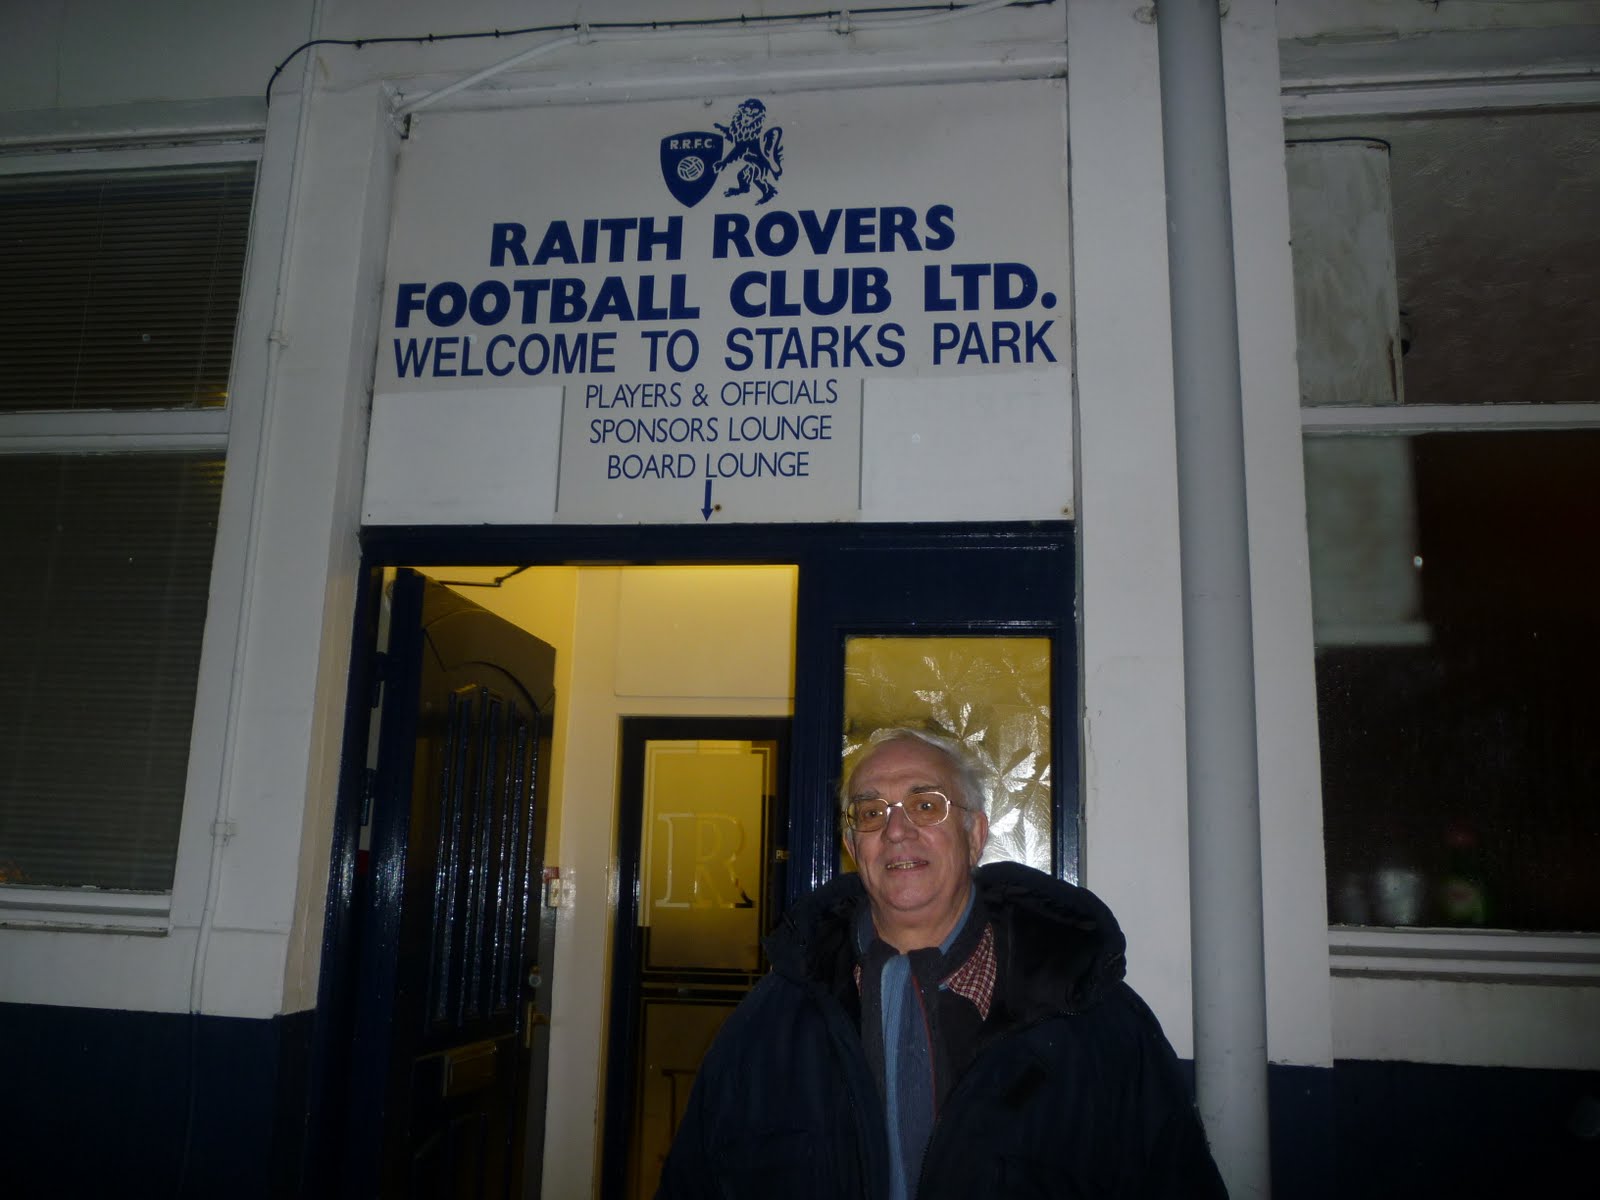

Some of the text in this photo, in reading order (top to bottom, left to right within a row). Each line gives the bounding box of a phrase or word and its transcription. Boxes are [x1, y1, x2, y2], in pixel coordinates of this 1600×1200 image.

[489, 203, 956, 268] RAITH ROVERS
[394, 262, 1058, 328] FOOTBALL CLUB LTD.
[393, 319, 1057, 378] WELCOME TO STARKS PARK
[585, 379, 839, 409] PLAYERS & OFFICIALS
[590, 414, 832, 444] SPONSORS LOUNGE
[607, 451, 809, 480] BOARD LOUNGE
